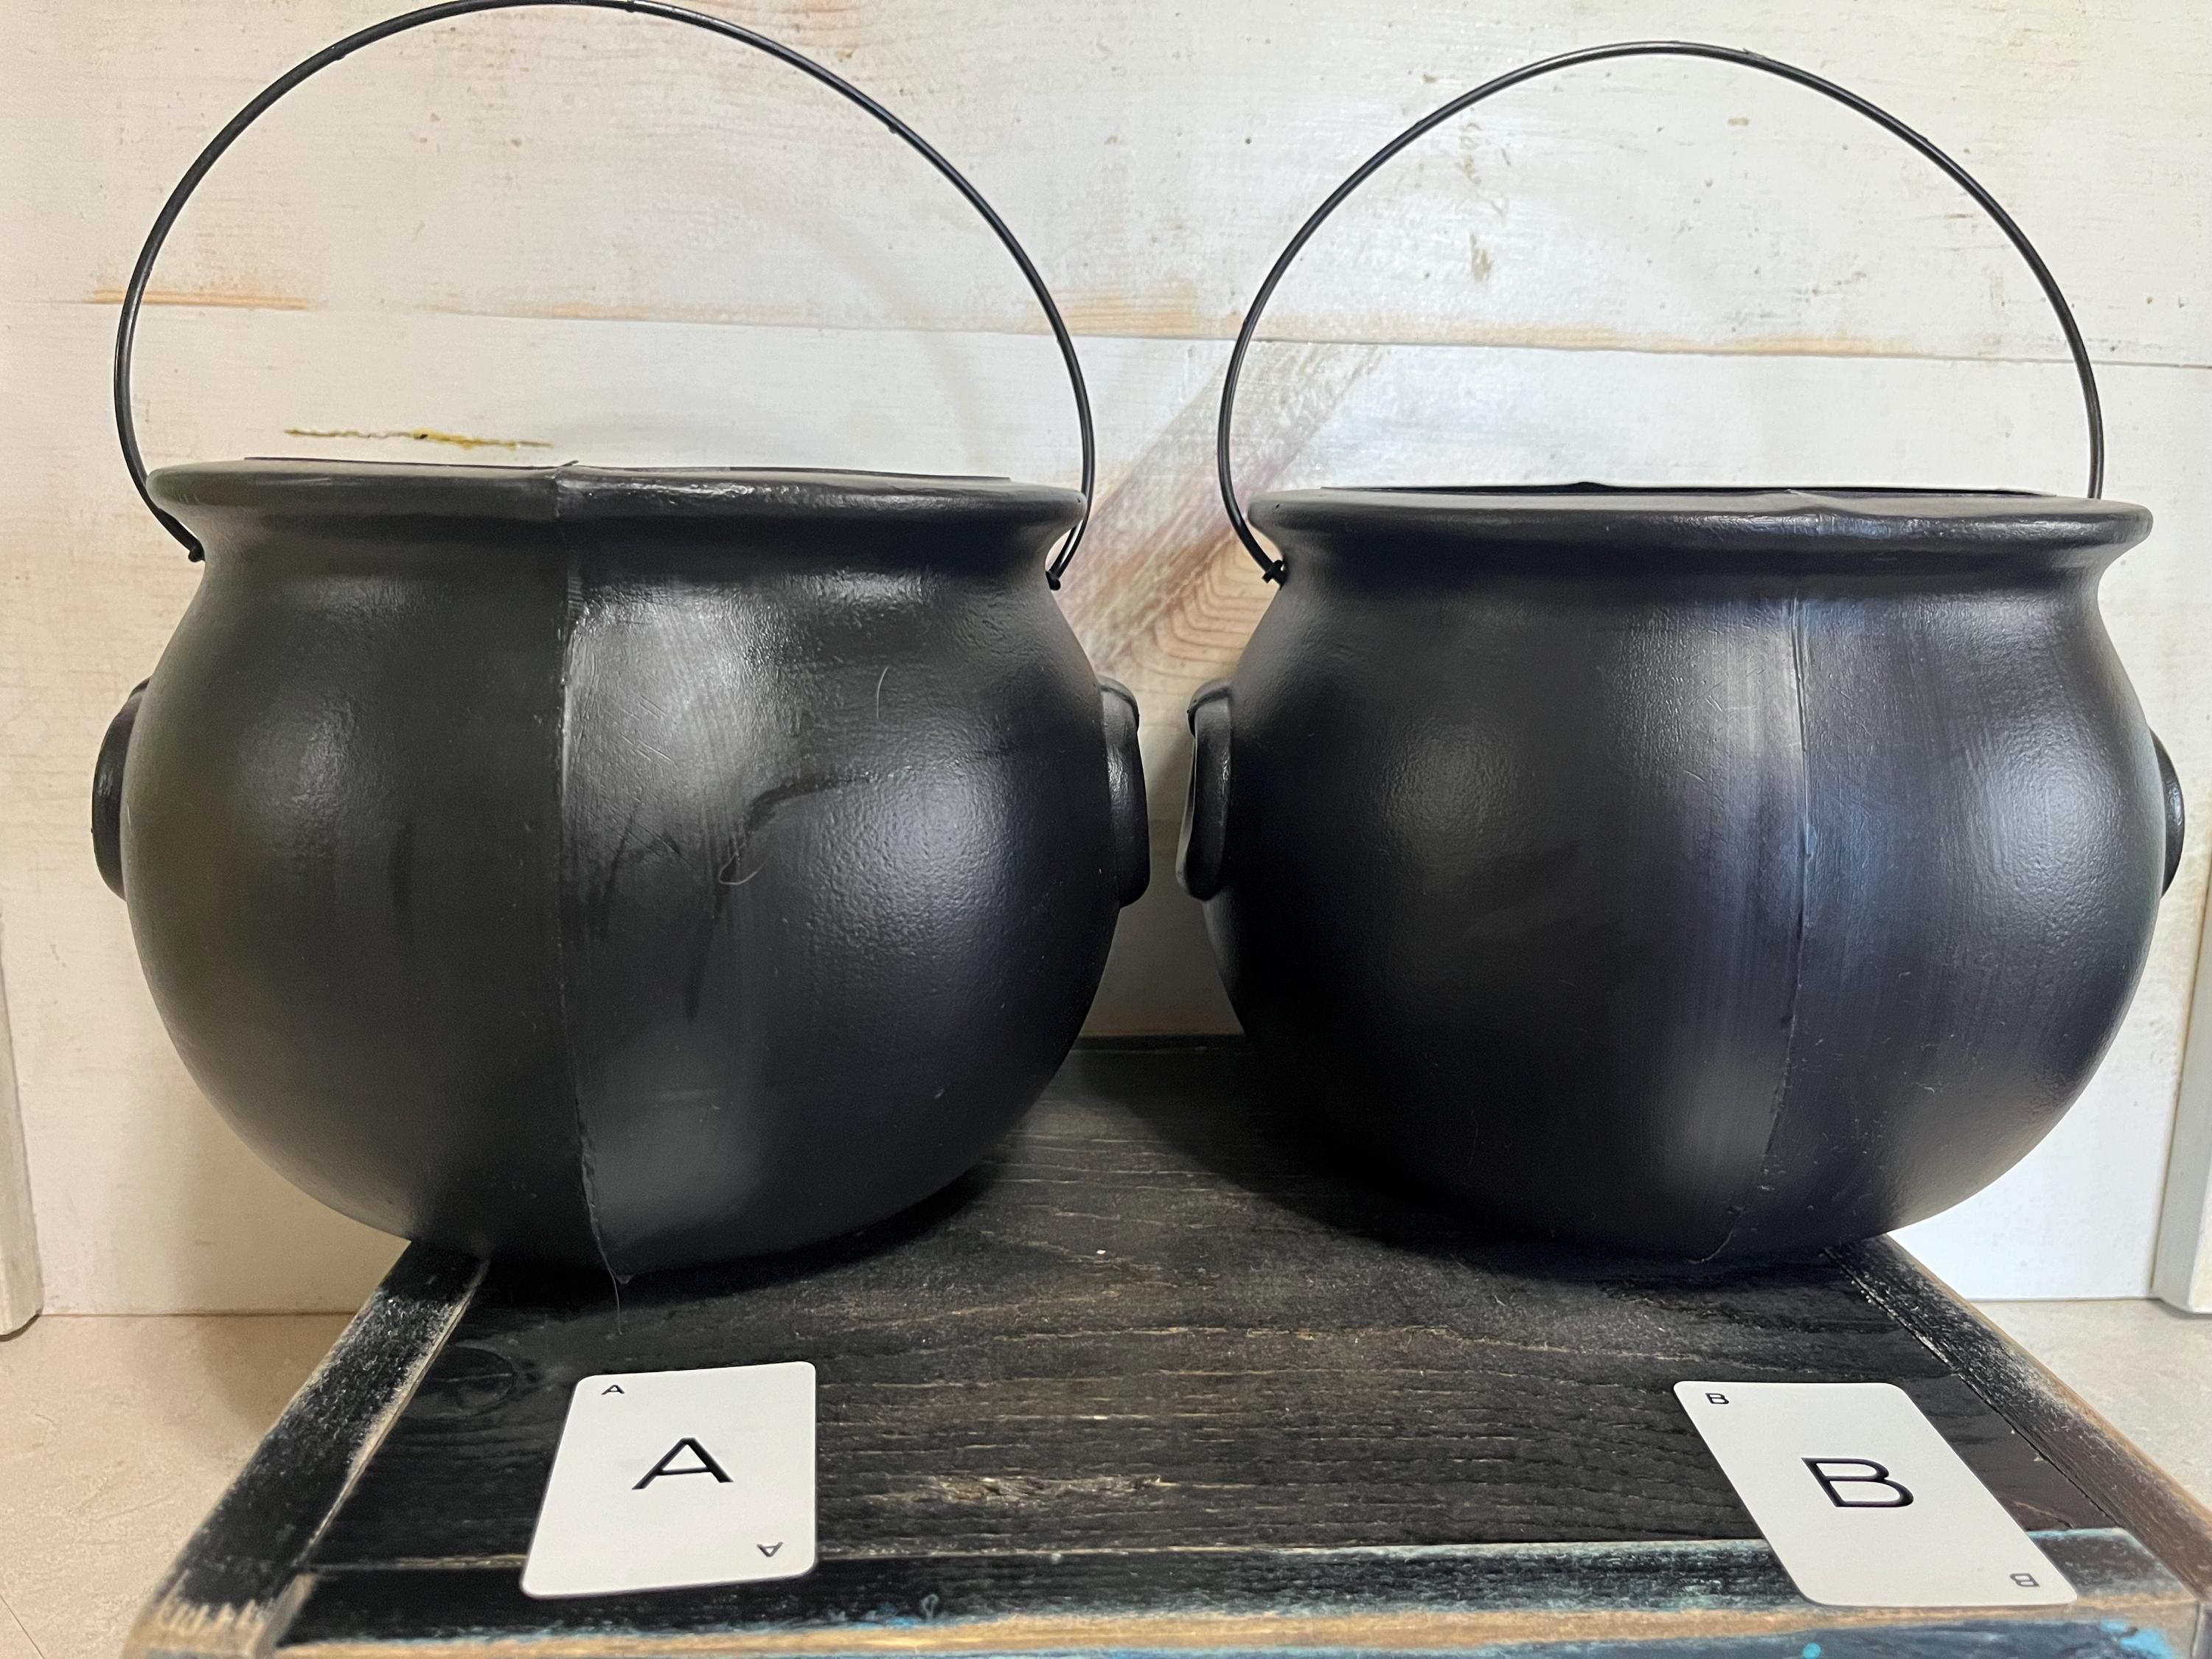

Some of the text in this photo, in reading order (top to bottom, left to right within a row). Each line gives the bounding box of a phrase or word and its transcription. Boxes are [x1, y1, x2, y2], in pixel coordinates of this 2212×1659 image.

[601, 1384, 625, 1395] A
[1705, 1393, 1730, 1405] B
[632, 1437, 734, 1489] A
[1801, 1457, 1914, 1508] B
[757, 1541, 783, 1557] A
[2009, 1573, 2040, 1587] B
